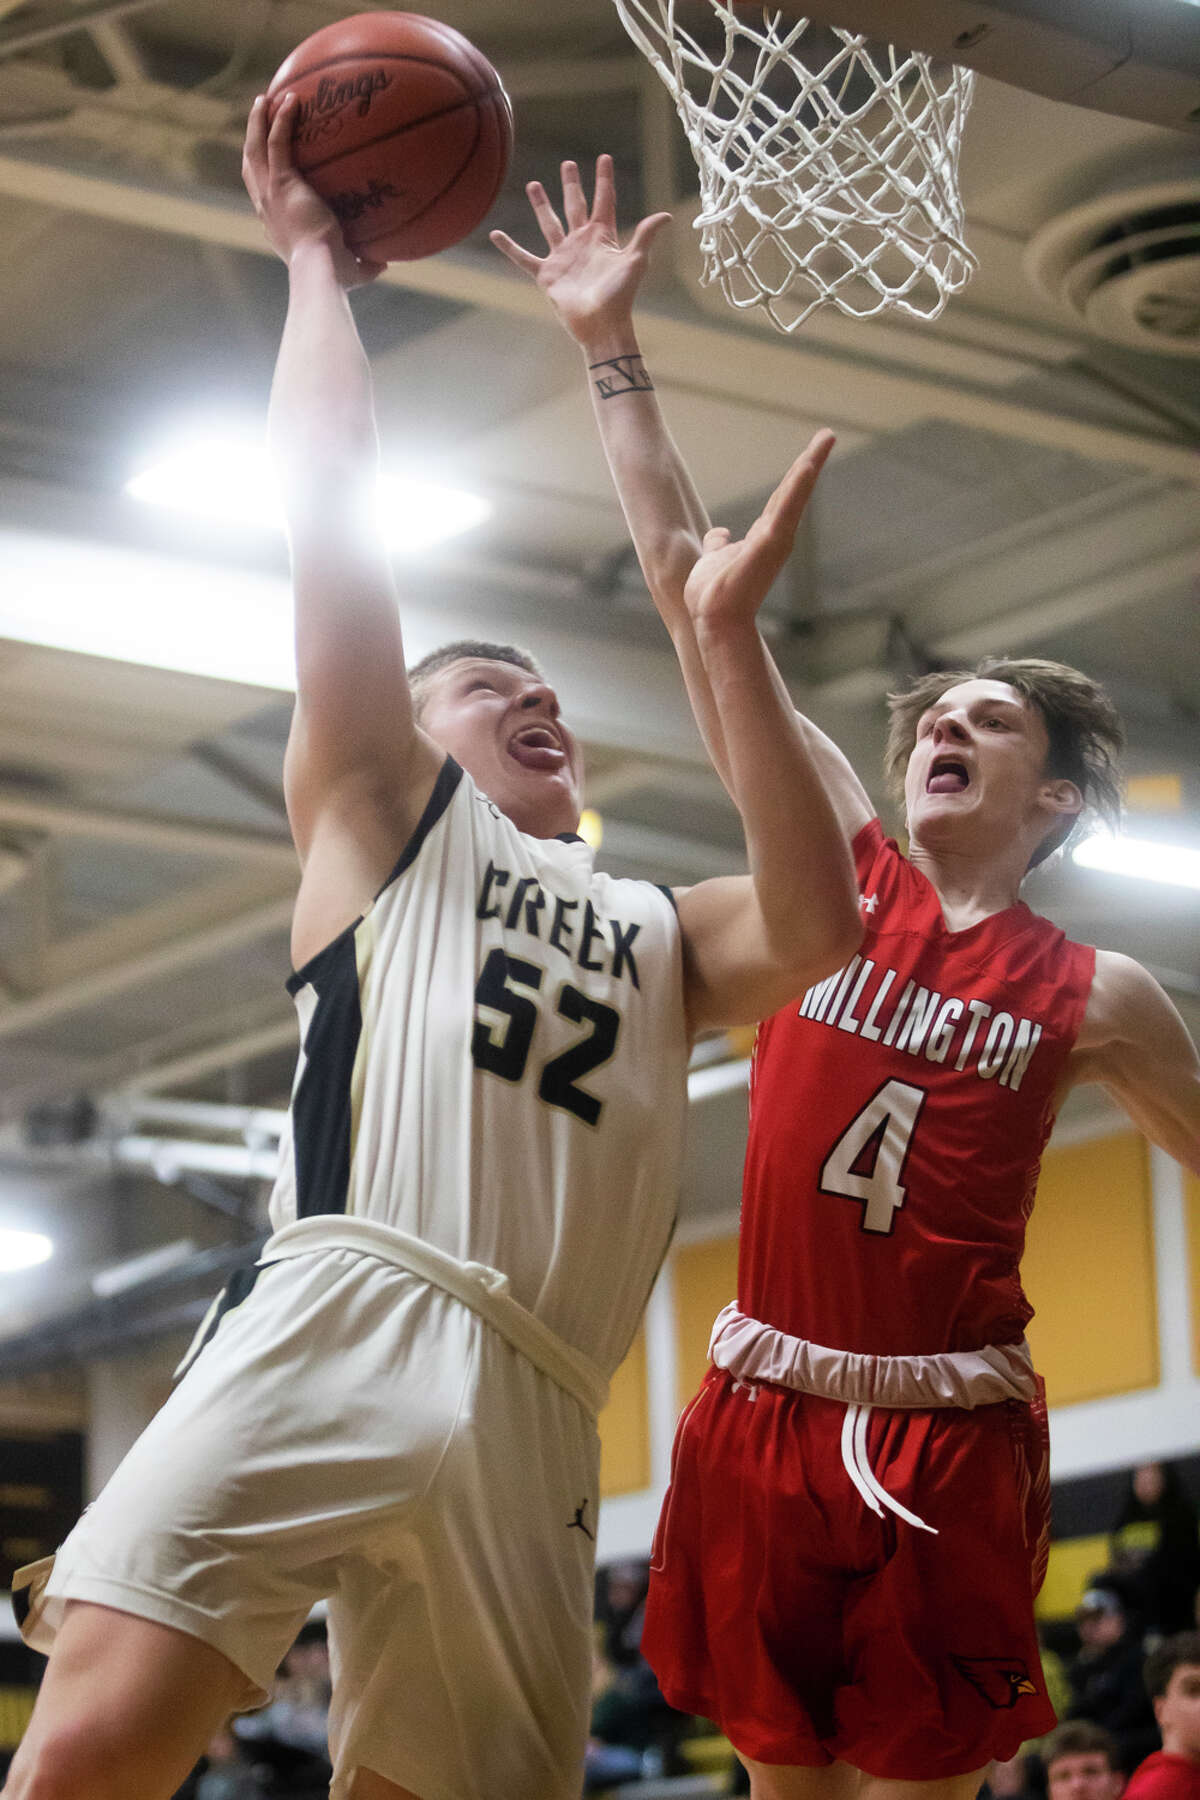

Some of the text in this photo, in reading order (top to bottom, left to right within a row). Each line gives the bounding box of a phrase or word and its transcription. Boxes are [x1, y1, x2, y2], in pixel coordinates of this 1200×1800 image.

[475, 858, 641, 990] CREEK
[470, 946, 622, 1128] 52
[797, 952, 1043, 1093] MILLINGTON
[817, 1076, 929, 1237] 4
